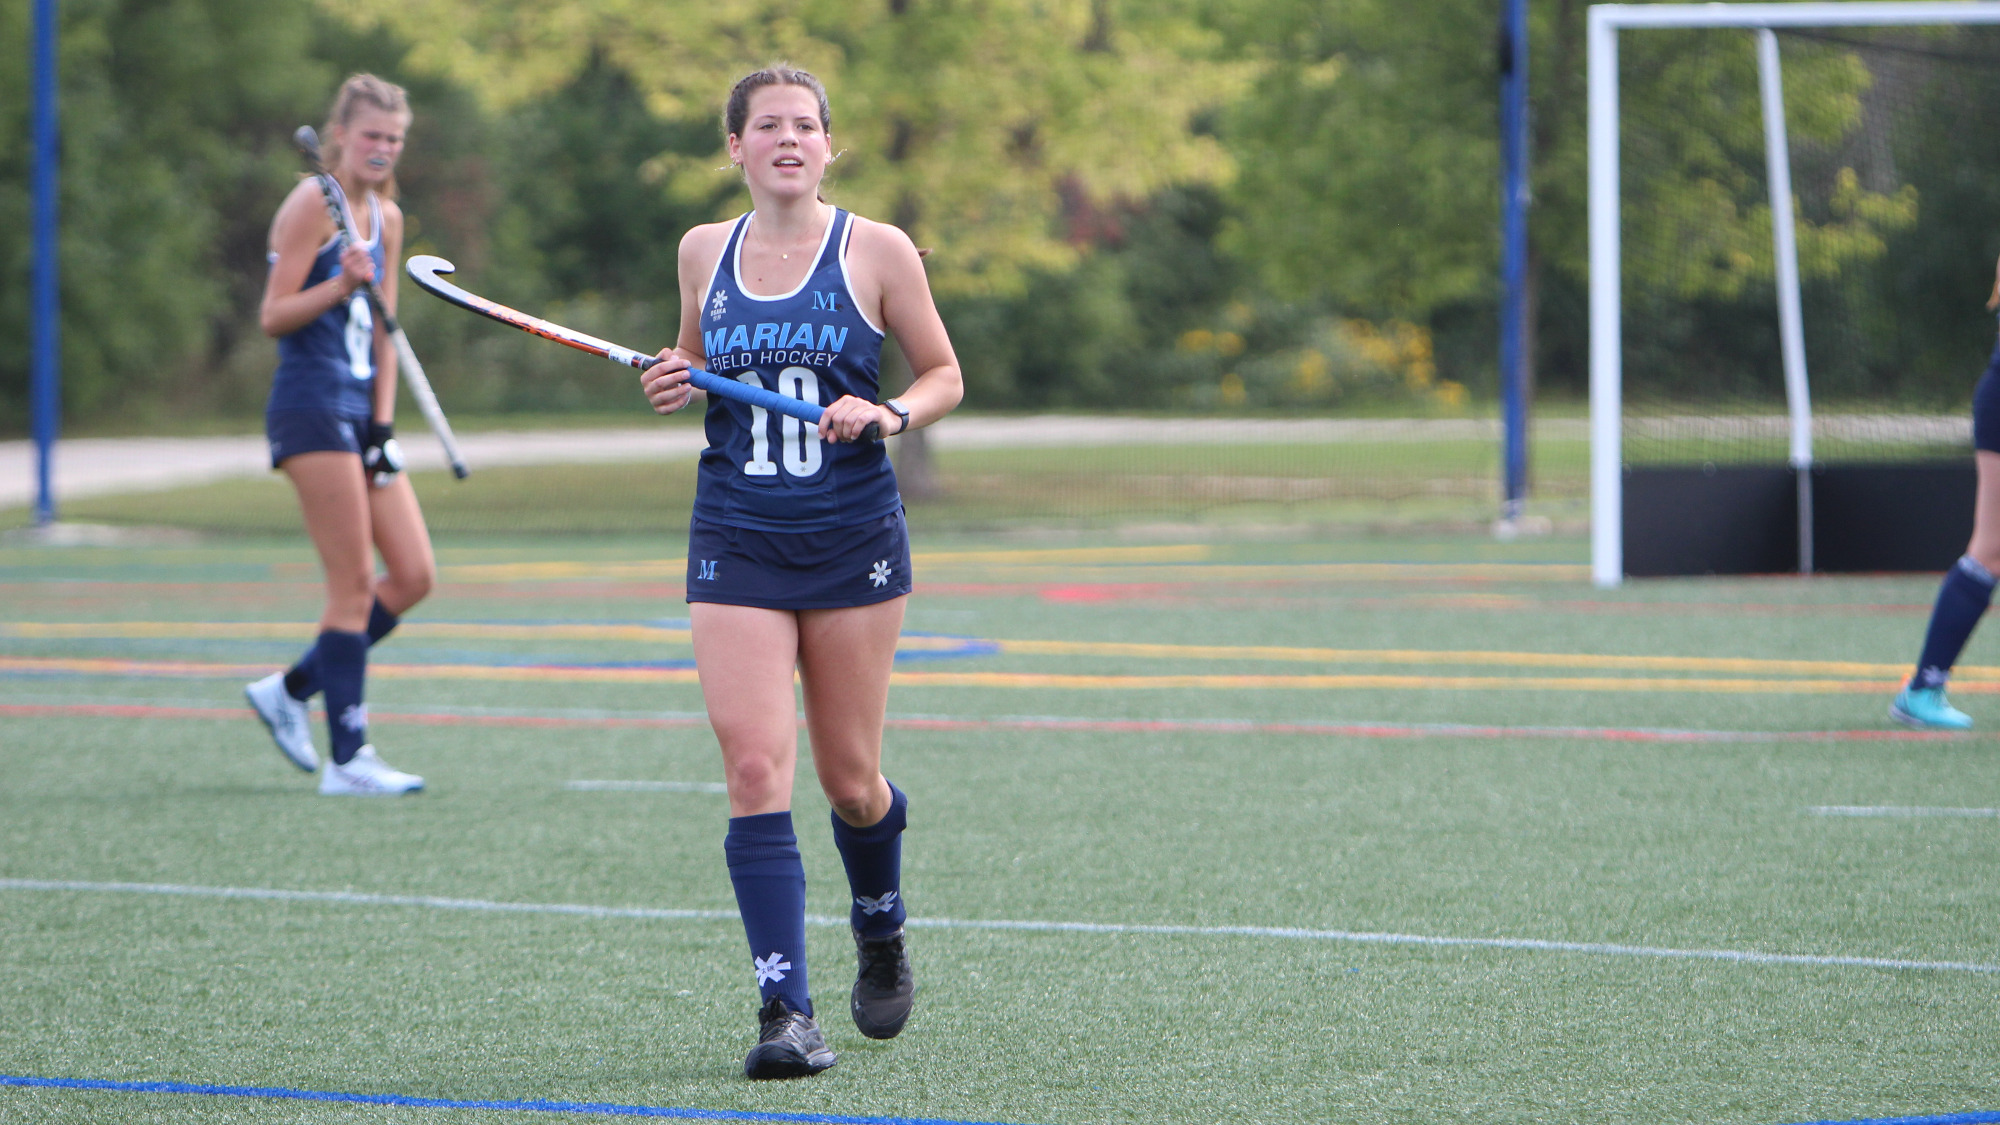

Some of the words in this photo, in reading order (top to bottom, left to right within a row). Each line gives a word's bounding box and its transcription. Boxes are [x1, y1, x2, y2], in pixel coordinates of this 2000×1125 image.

[813, 291, 837, 312] M
[705, 322, 848, 358] MARIAN
[713, 352, 752, 371] FIELD
[760, 351, 838, 367] HOCKEY
[737, 366, 823, 478] 10
[697, 559, 718, 581] M
